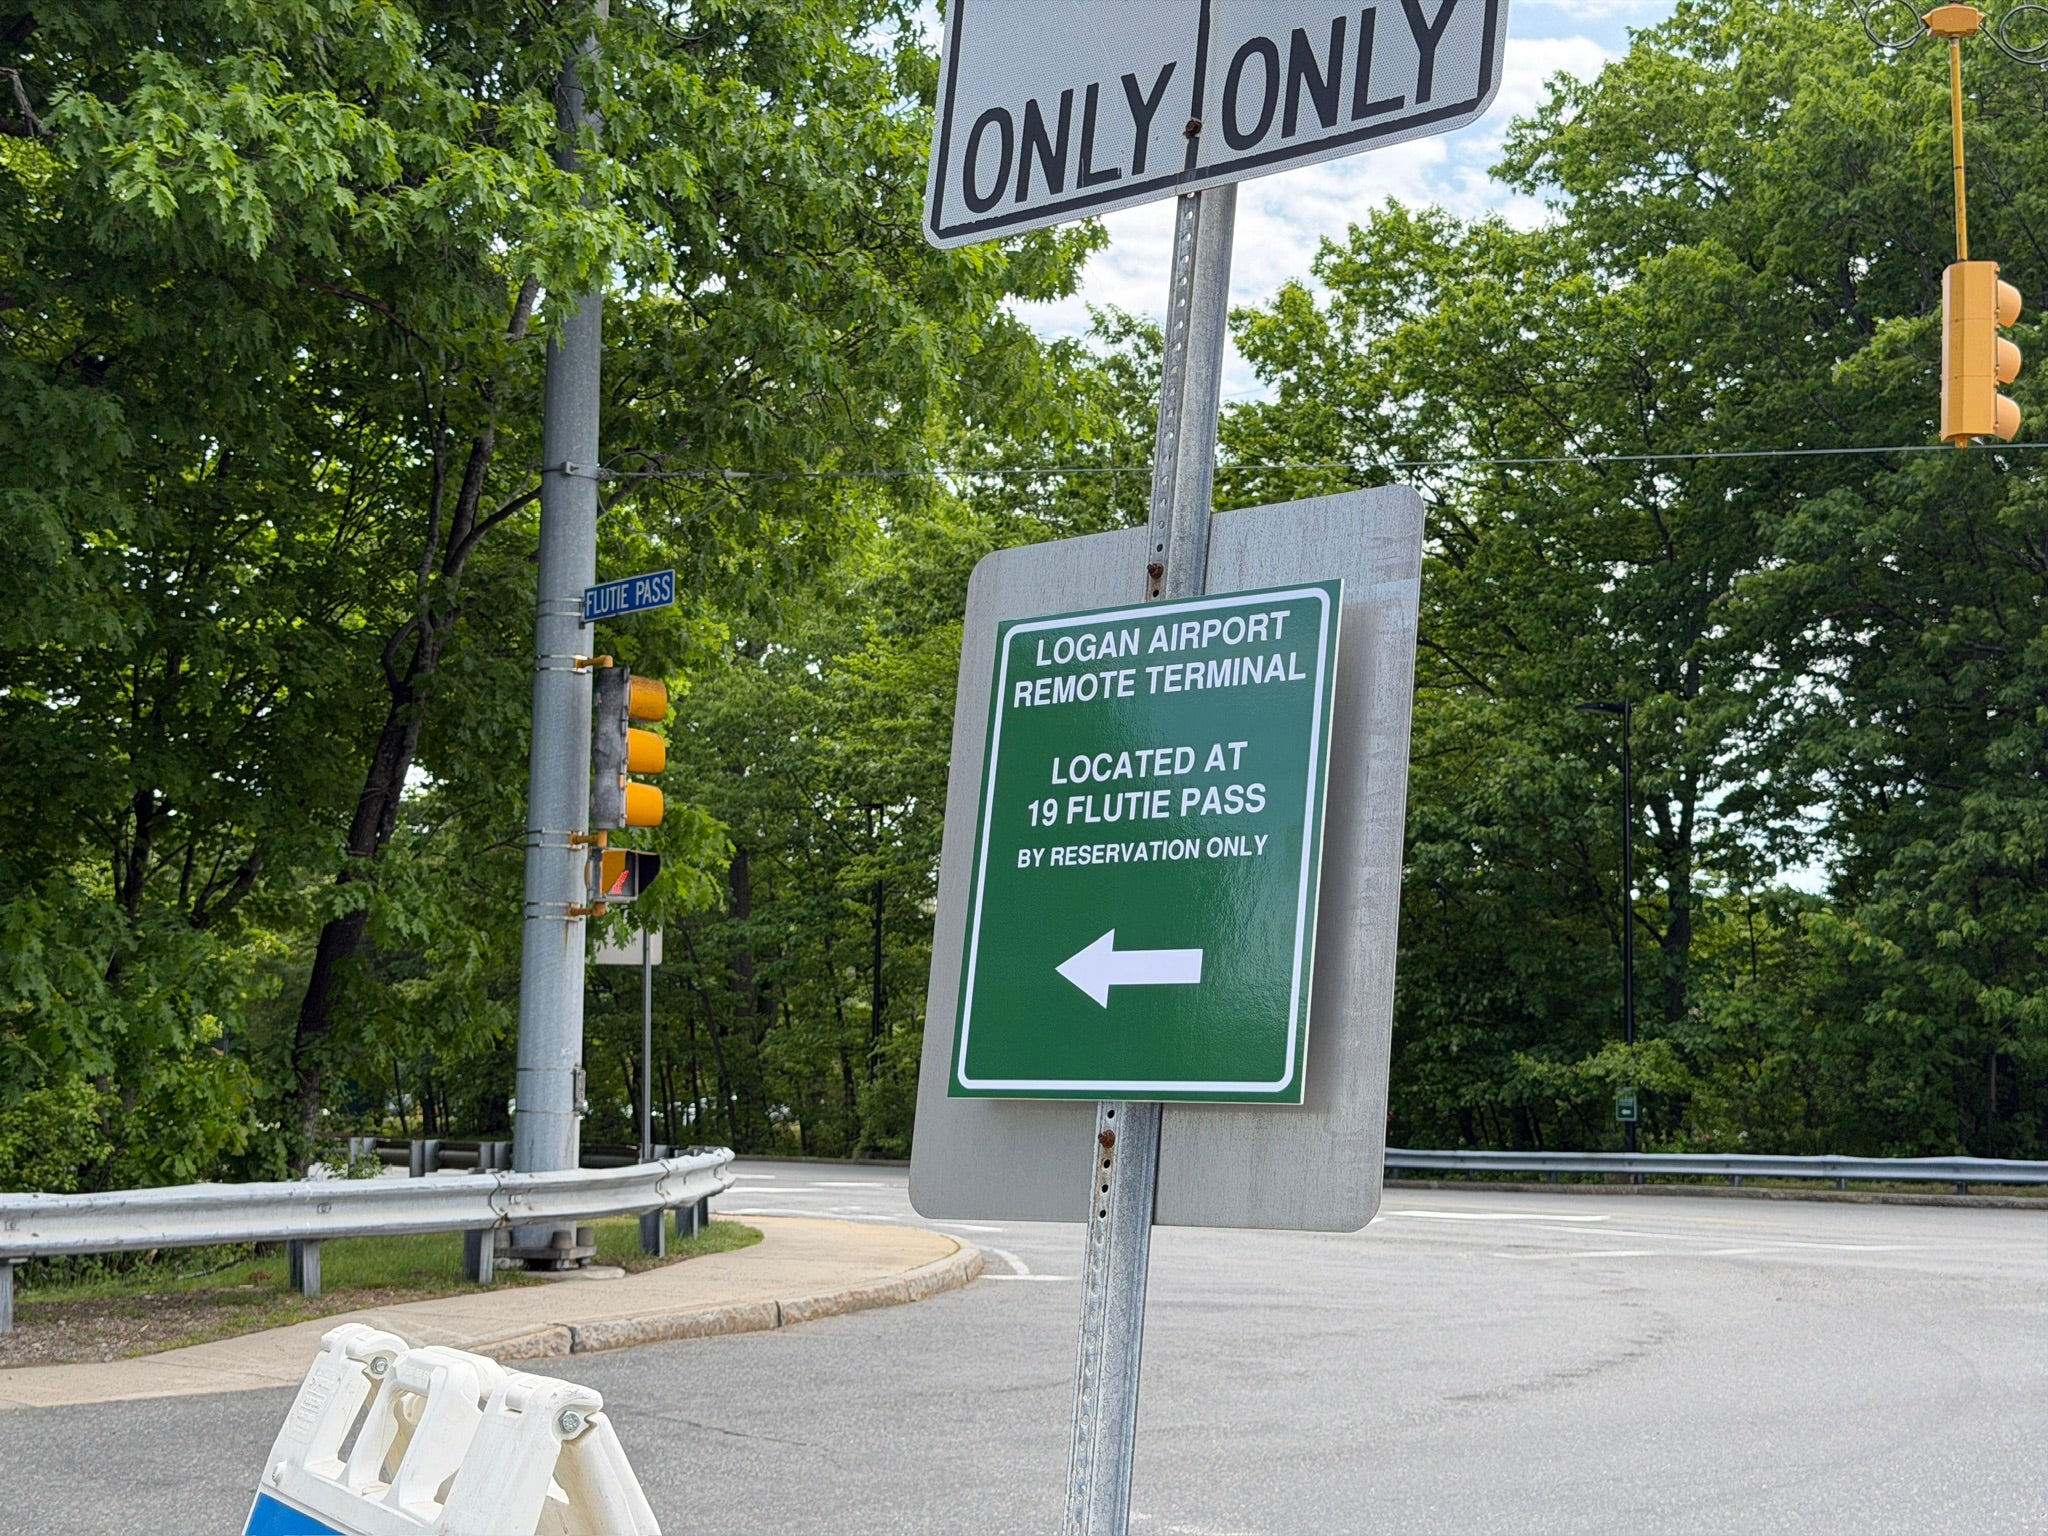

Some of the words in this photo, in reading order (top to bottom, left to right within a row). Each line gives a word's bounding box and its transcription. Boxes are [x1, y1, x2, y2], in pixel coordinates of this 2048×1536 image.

[1222, 0, 1460, 151] ONLY
[963, 61, 1177, 213] ONLY
[586, 584, 629, 617] FLUTIE
[635, 575, 671, 606] PASS
[1036, 628, 1140, 666] LOGAN
[1148, 610, 1291, 653] AIRPORT
[1013, 669, 1136, 708] REMOTE
[1146, 652, 1306, 695] TERMINAL
[1051, 746, 1195, 785] LOCATED
[1204, 741, 1248, 772] AT
[1028, 798, 1058, 827] 19
[1066, 789, 1170, 824] FLUTIE
[1180, 783, 1266, 817] PASS
[1017, 848, 1045, 868] BY
[1050, 838, 1200, 867] RESERVATION
[1206, 834, 1268, 859] ONLY
